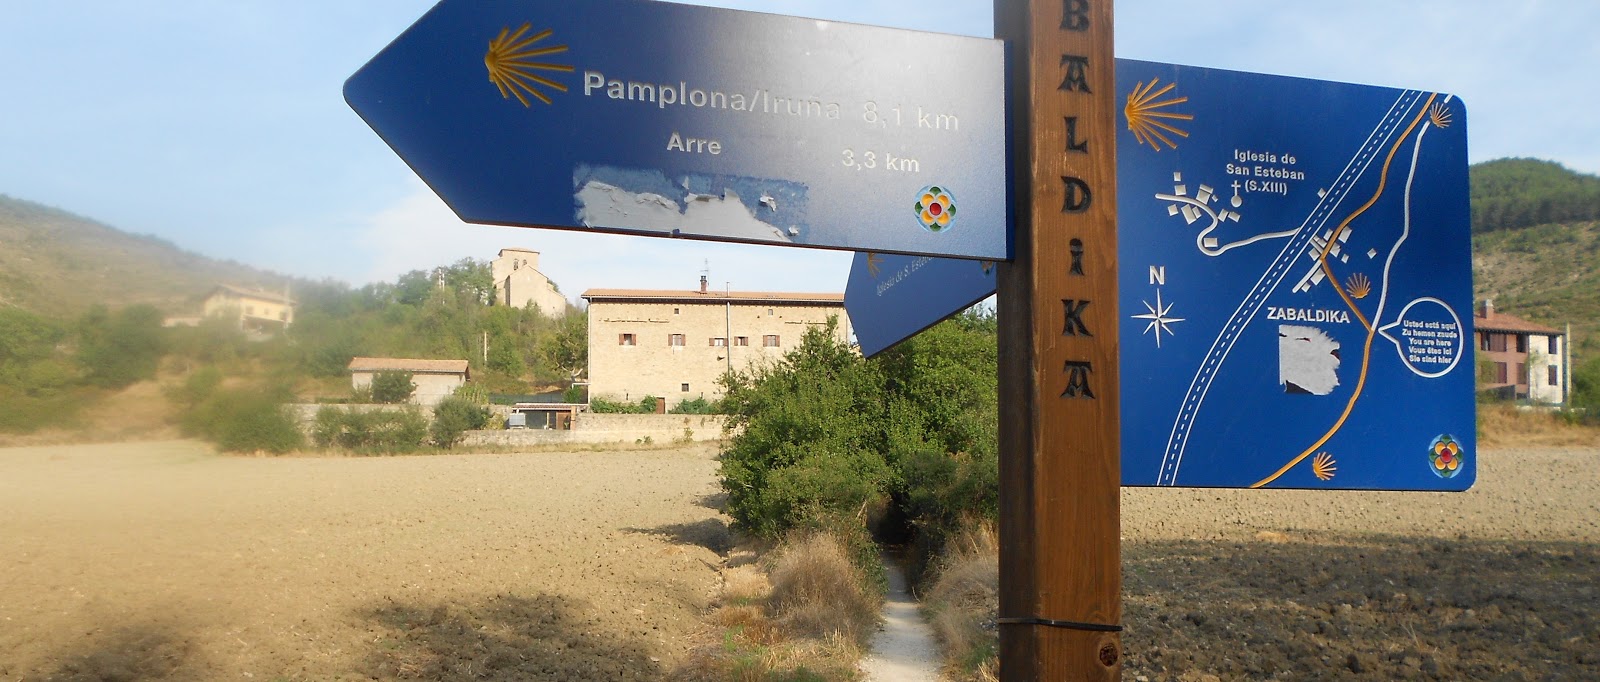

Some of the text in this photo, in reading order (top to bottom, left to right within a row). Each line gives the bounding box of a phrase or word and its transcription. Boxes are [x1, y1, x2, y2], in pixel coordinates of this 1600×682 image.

[583, 70, 959, 131] Pamplona/Iruña 8,1 km
[666, 131, 920, 173] Arre 3,3 km
[1234, 148, 1297, 165] Iglesia de
[1226, 163, 1305, 181] San Esteban
[1244, 179, 1288, 196] (S.XIII)
[1149, 265, 1165, 285] N
[1266, 306, 1351, 323] ZABALDIKA
[1402, 328, 1412, 336] Zu
[1413, 329, 1436, 337] hemen
[1403, 320, 1423, 328] Usted
[1425, 320, 1440, 329] está
[1409, 337, 1423, 345] You
[1436, 338, 1452, 347] here
[1409, 346, 1426, 354] Vous
[1427, 347, 1442, 355] êtes
[1409, 354, 1421, 362] Sie
[1422, 355, 1437, 363] sind
